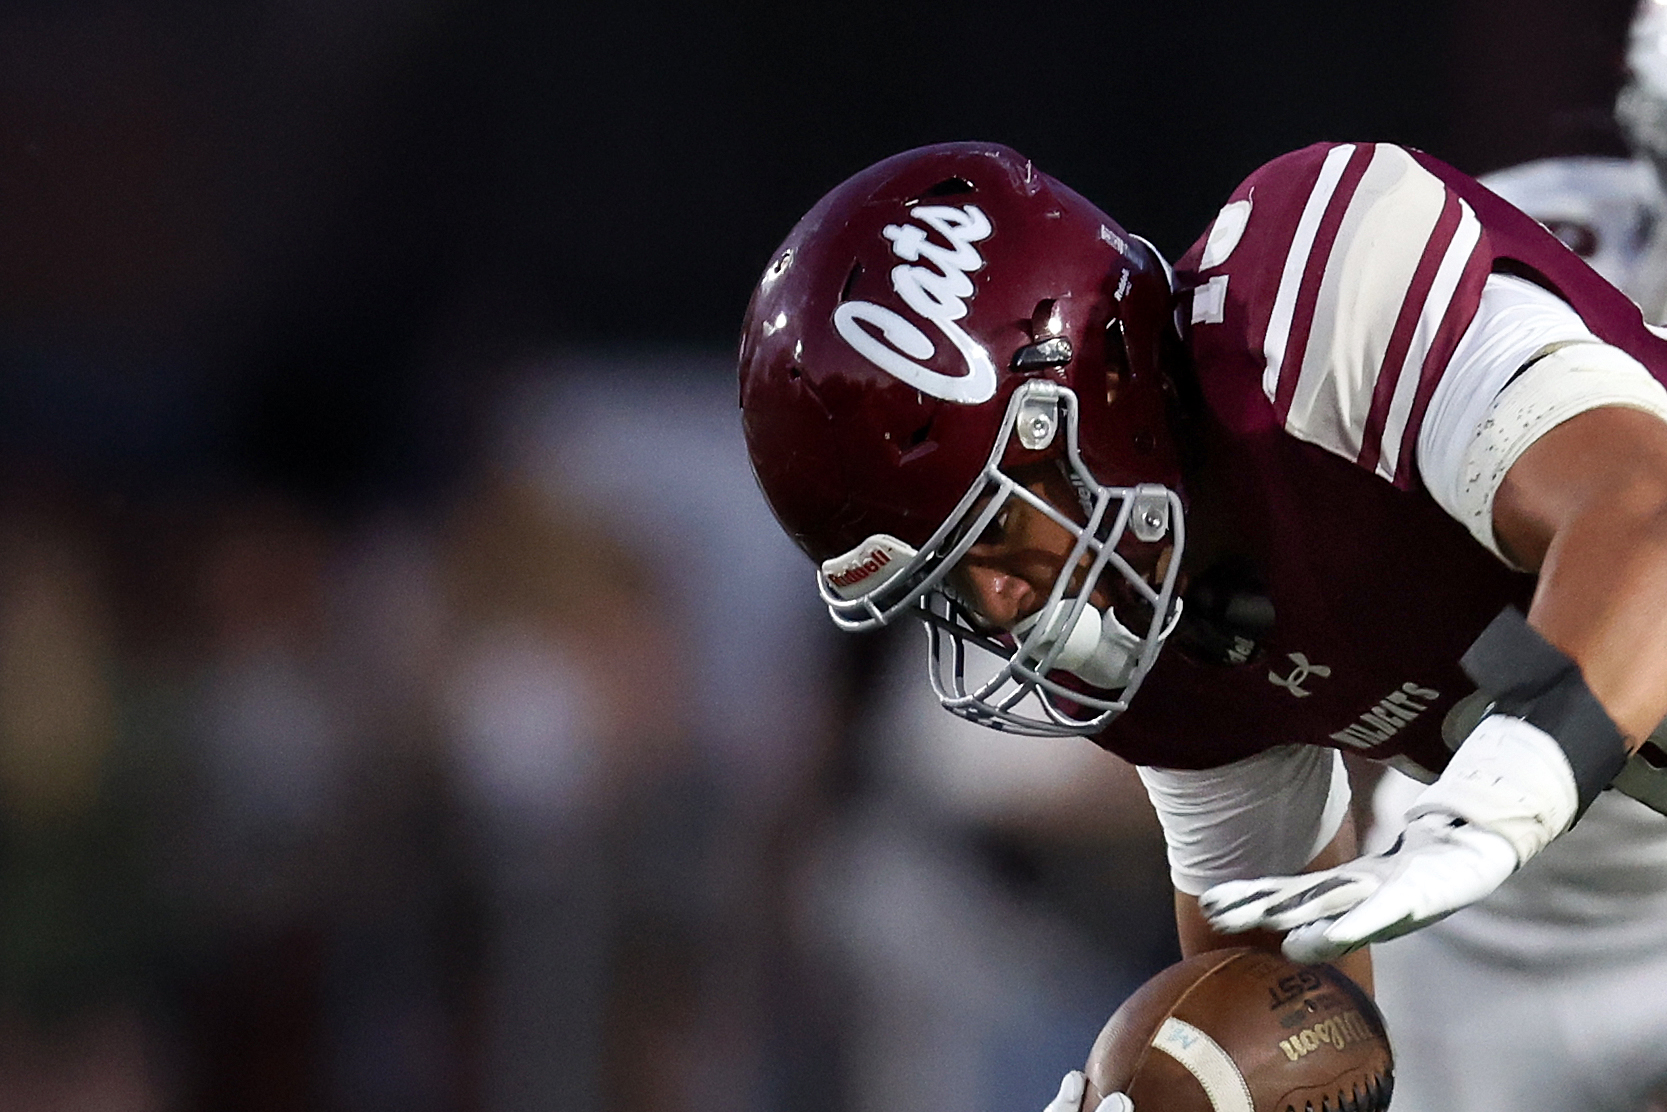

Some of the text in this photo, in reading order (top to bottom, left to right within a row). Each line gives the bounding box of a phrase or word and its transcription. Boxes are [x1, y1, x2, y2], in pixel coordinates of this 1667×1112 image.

[833, 203, 998, 404] Cats
[1329, 681, 1441, 750] WILDCATS
[1278, 1011, 1376, 1062] Wilson
